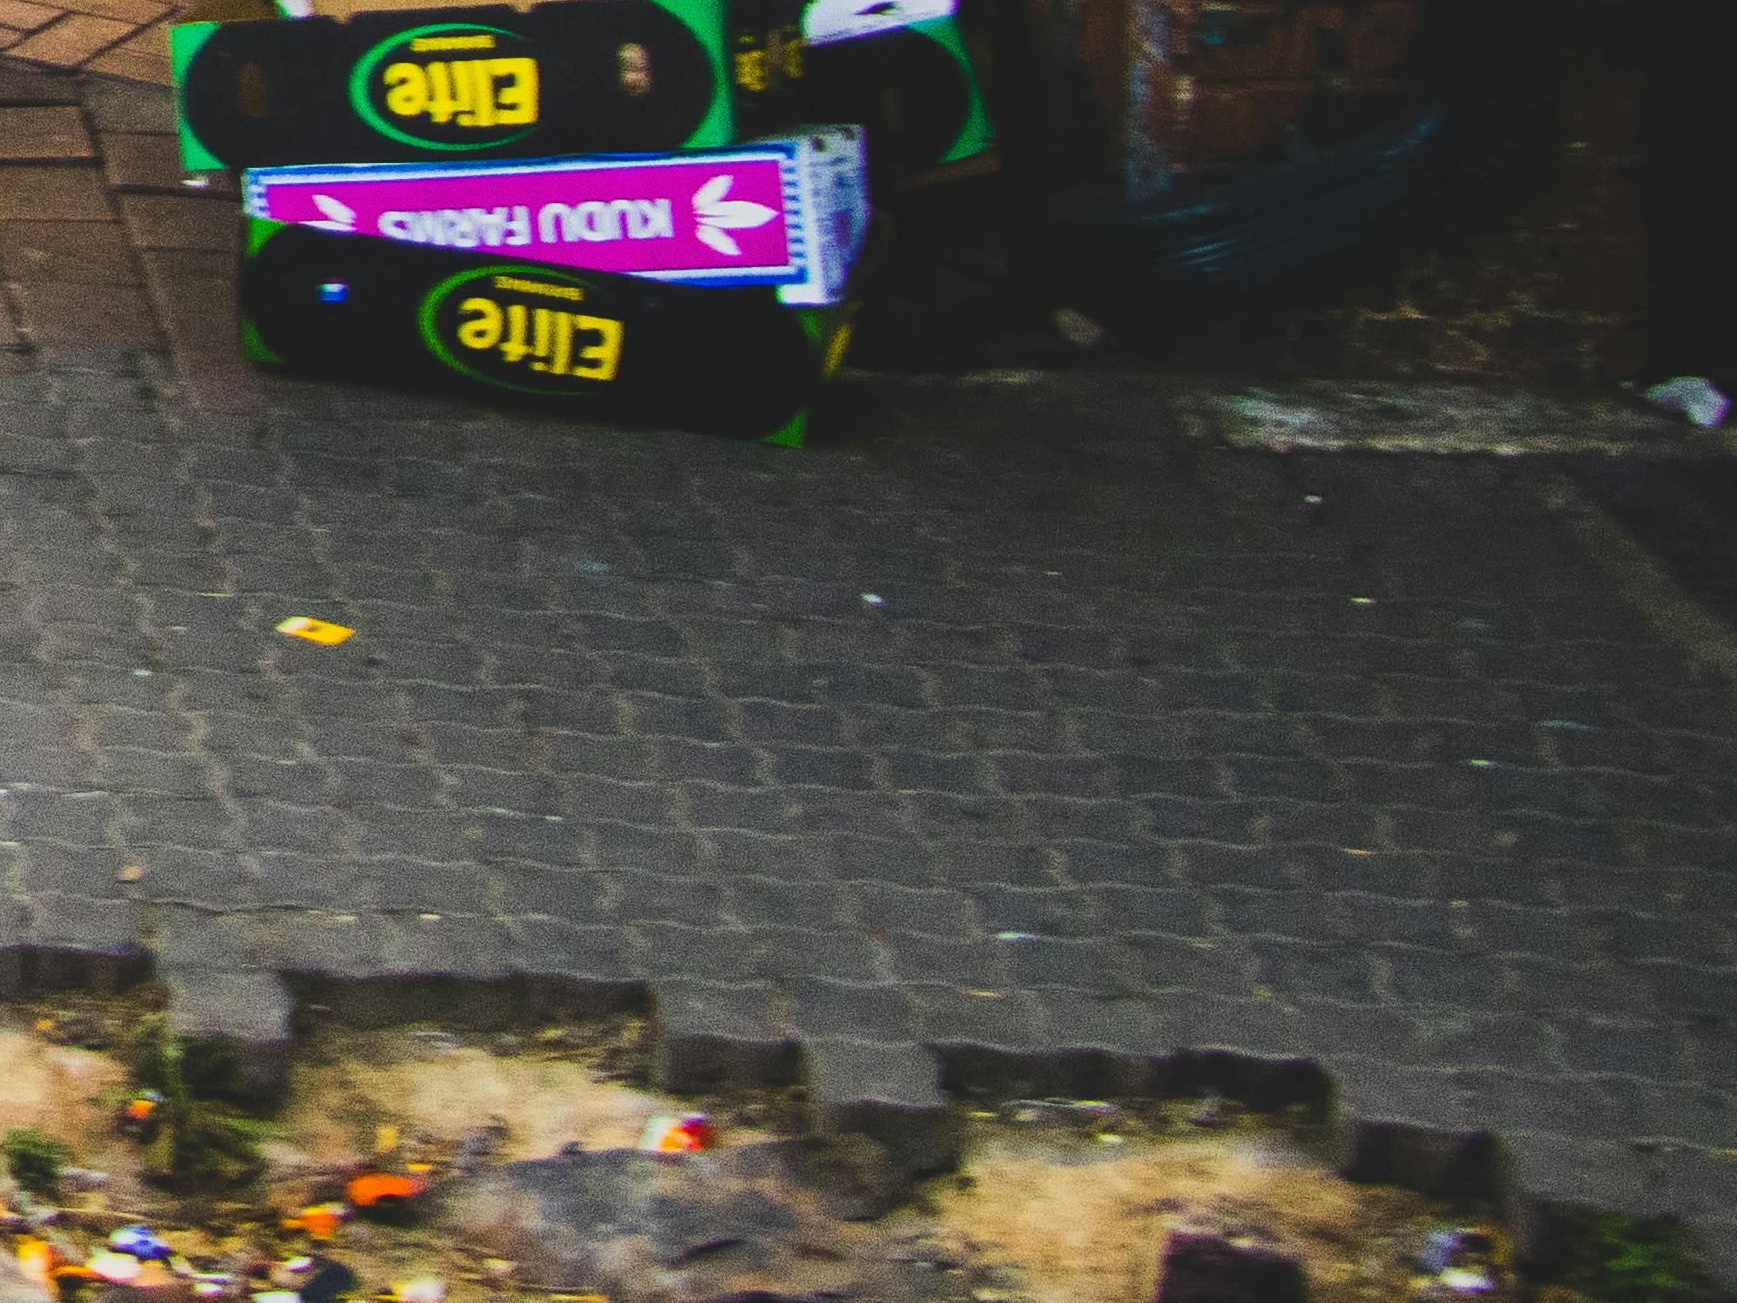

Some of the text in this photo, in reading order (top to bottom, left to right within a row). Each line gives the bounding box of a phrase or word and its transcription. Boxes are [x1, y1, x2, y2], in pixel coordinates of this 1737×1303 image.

[382, 56, 541, 131] Elite
[375, 198, 674, 251] KUDU FARMS
[456, 294, 627, 384] Elite
